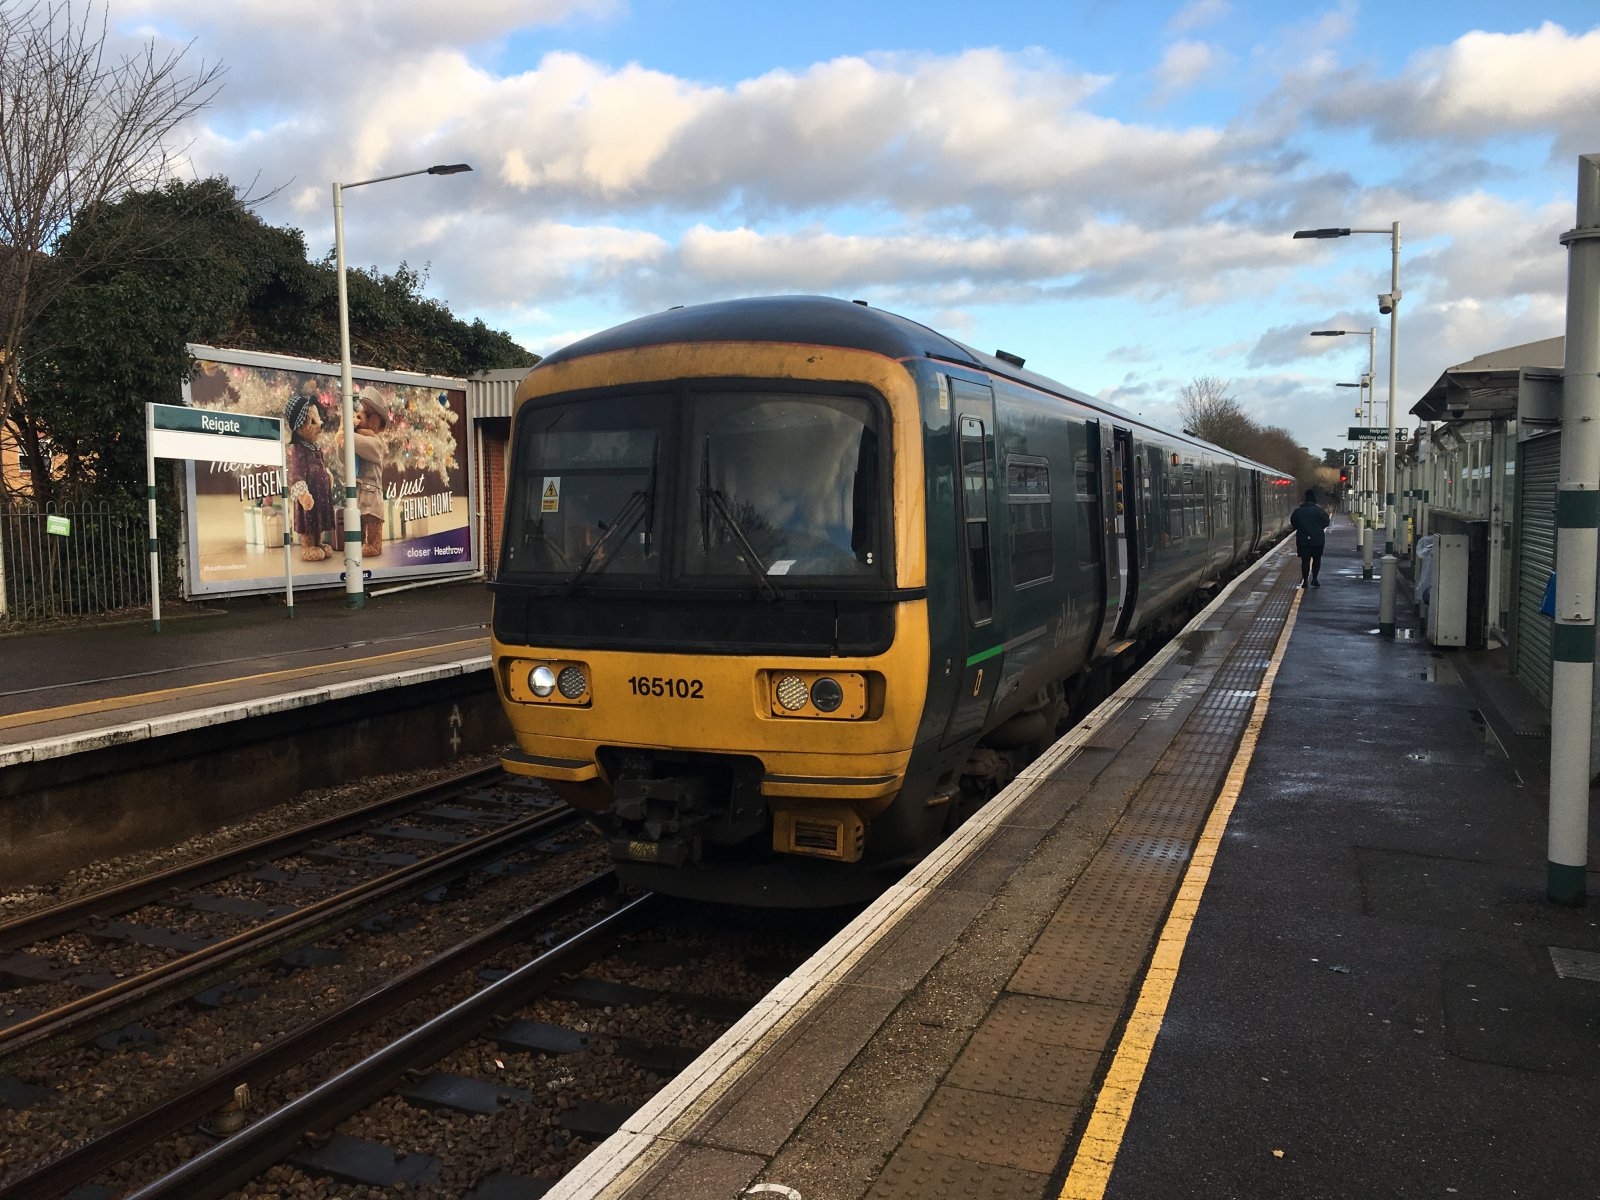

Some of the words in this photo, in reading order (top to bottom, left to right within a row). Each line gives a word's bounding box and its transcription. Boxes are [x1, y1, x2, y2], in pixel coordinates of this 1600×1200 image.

[201, 414, 240, 434] Reigate
[1348, 454, 1355, 465] 2
[239, 468, 288, 502] PRESEN
[386, 481, 397, 499] is
[394, 473, 425, 510] just
[403, 496, 428, 522] BEING
[431, 490, 453, 517] HOME
[407, 546, 431, 558] closer
[434, 545, 464, 556] Heathrow
[628, 676, 704, 699] 165102
